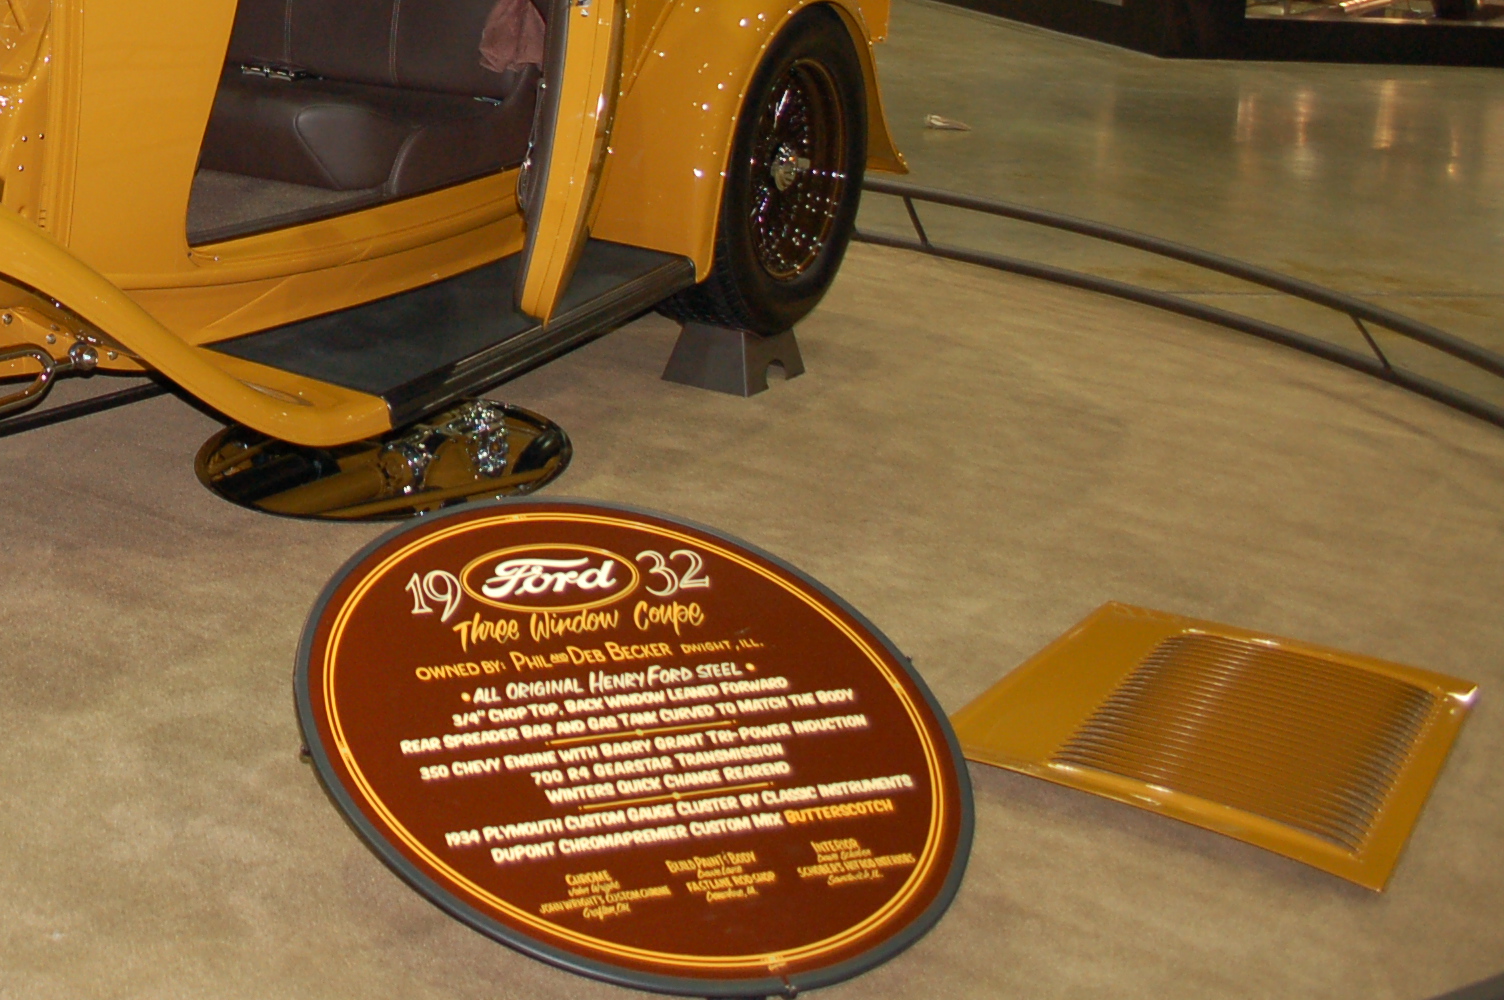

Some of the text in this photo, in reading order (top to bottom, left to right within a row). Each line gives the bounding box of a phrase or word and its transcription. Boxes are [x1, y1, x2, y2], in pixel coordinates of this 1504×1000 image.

[405, 550, 710, 622] 19 Ford 32
[452, 601, 705, 653] Three Window Coupe
[415, 662, 481, 681] OWNED
[481, 659, 507, 676] BY:
[509, 651, 554, 672] PHIL
[566, 646, 606, 665] DEB
[604, 641, 673, 662] BECKER
[473, 662, 744, 704] ALL ORIGINAL HENRY FORD STEEL
[400, 687, 854, 755] REAR SPREADER BAR AND GAS TANK CURVED TO MATCH THE BODY
[488, 706, 527, 723] CHOP
[564, 698, 604, 714] BACK
[603, 690, 666, 709] WINDOW
[666, 684, 719, 701] LEANED
[719, 676, 789, 696] FORWARD
[419, 764, 450, 781] 350
[451, 757, 501, 777] CHEVY
[502, 750, 558, 770] ENGINE
[557, 745, 599, 764] WITH
[599, 738, 652, 757] BARRY
[653, 732, 705, 751] GRANT
[791, 713, 868, 735] INDUCTION
[530, 742, 785, 787] 700 R4 GEARSTAR TRANSMISSION
[544, 761, 791, 805] WINTERS QUICK CHANGE REAREND
[444, 774, 914, 848] 1934 PLYMOUTH CUSTOM GAUGE CLUSTER BY CLASSIC INSTRUMENTS
[490, 798, 895, 864] DUPONT CHROMAPREMIER CUSTOM MIX BUTTERSCOTCH
[665, 859, 697, 874] BUILD
[692, 853, 725, 869] PAINT
[727, 850, 757, 865] BODY
[810, 838, 860, 854] INTERIOR
[564, 869, 613, 886] CHROME
